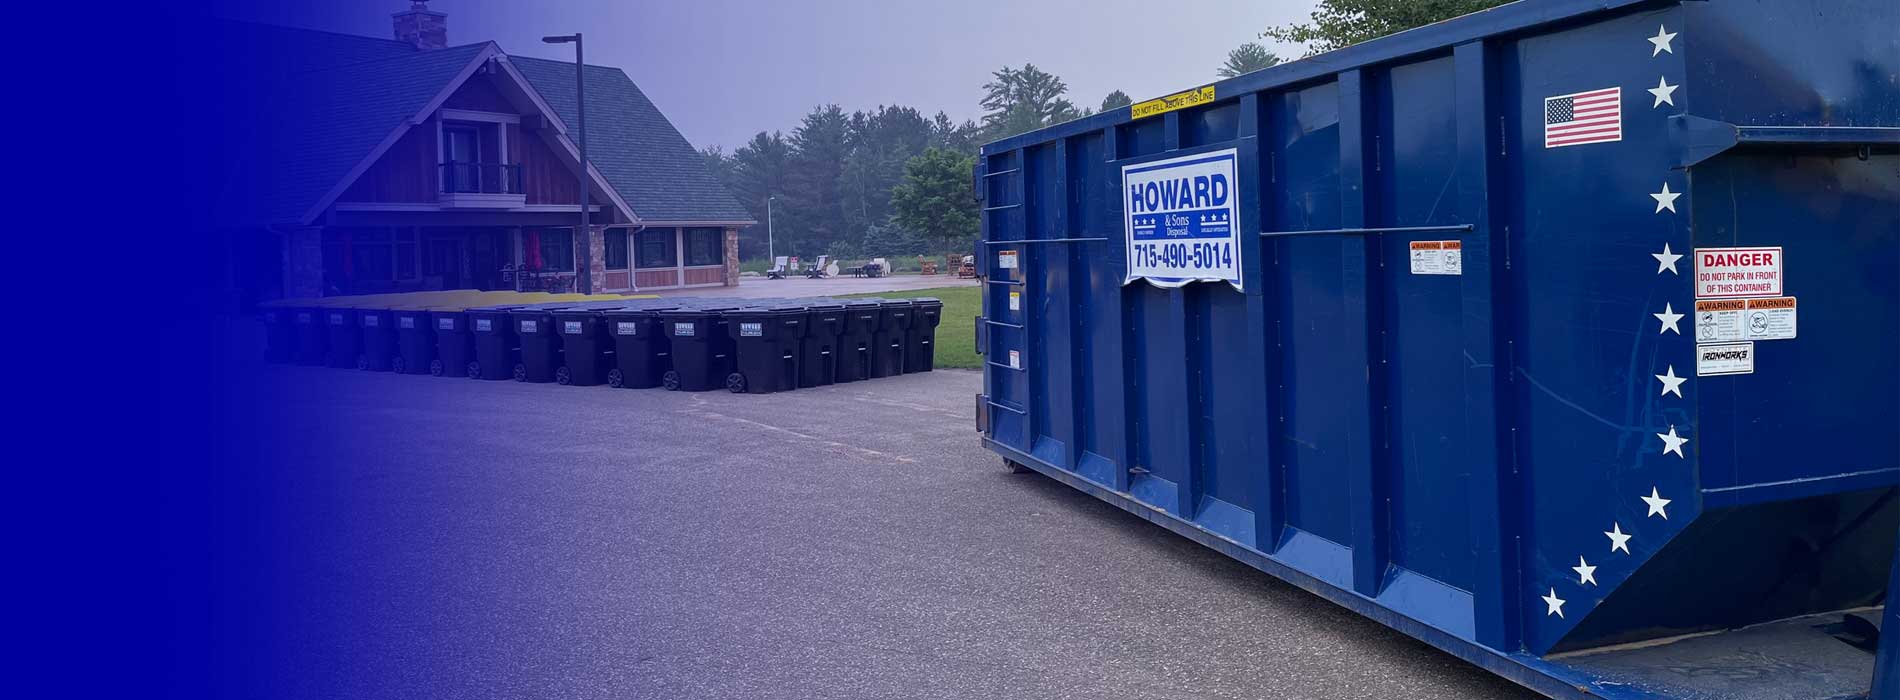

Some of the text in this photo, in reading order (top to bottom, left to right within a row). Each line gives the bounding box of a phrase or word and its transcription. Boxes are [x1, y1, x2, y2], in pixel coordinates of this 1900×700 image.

[1132, 90, 1214, 117] DO NOT FILL ABOVE THIS LINE
[1131, 173, 1228, 212] HOWARD
[1165, 213, 1190, 227] & Sons
[1166, 226, 1189, 238] Disposal
[1134, 242, 1232, 269] 715-490-5014
[1704, 253, 1773, 267] DANGER
[1700, 271, 1777, 282] DO NOT PARK IN FRONT
[1706, 282, 1772, 293] OF THIS CONTAINER
[1703, 301, 1744, 311] WARNING
[1754, 299, 1794, 309] WARNING
[1702, 350, 1748, 362] IRONWORKS
